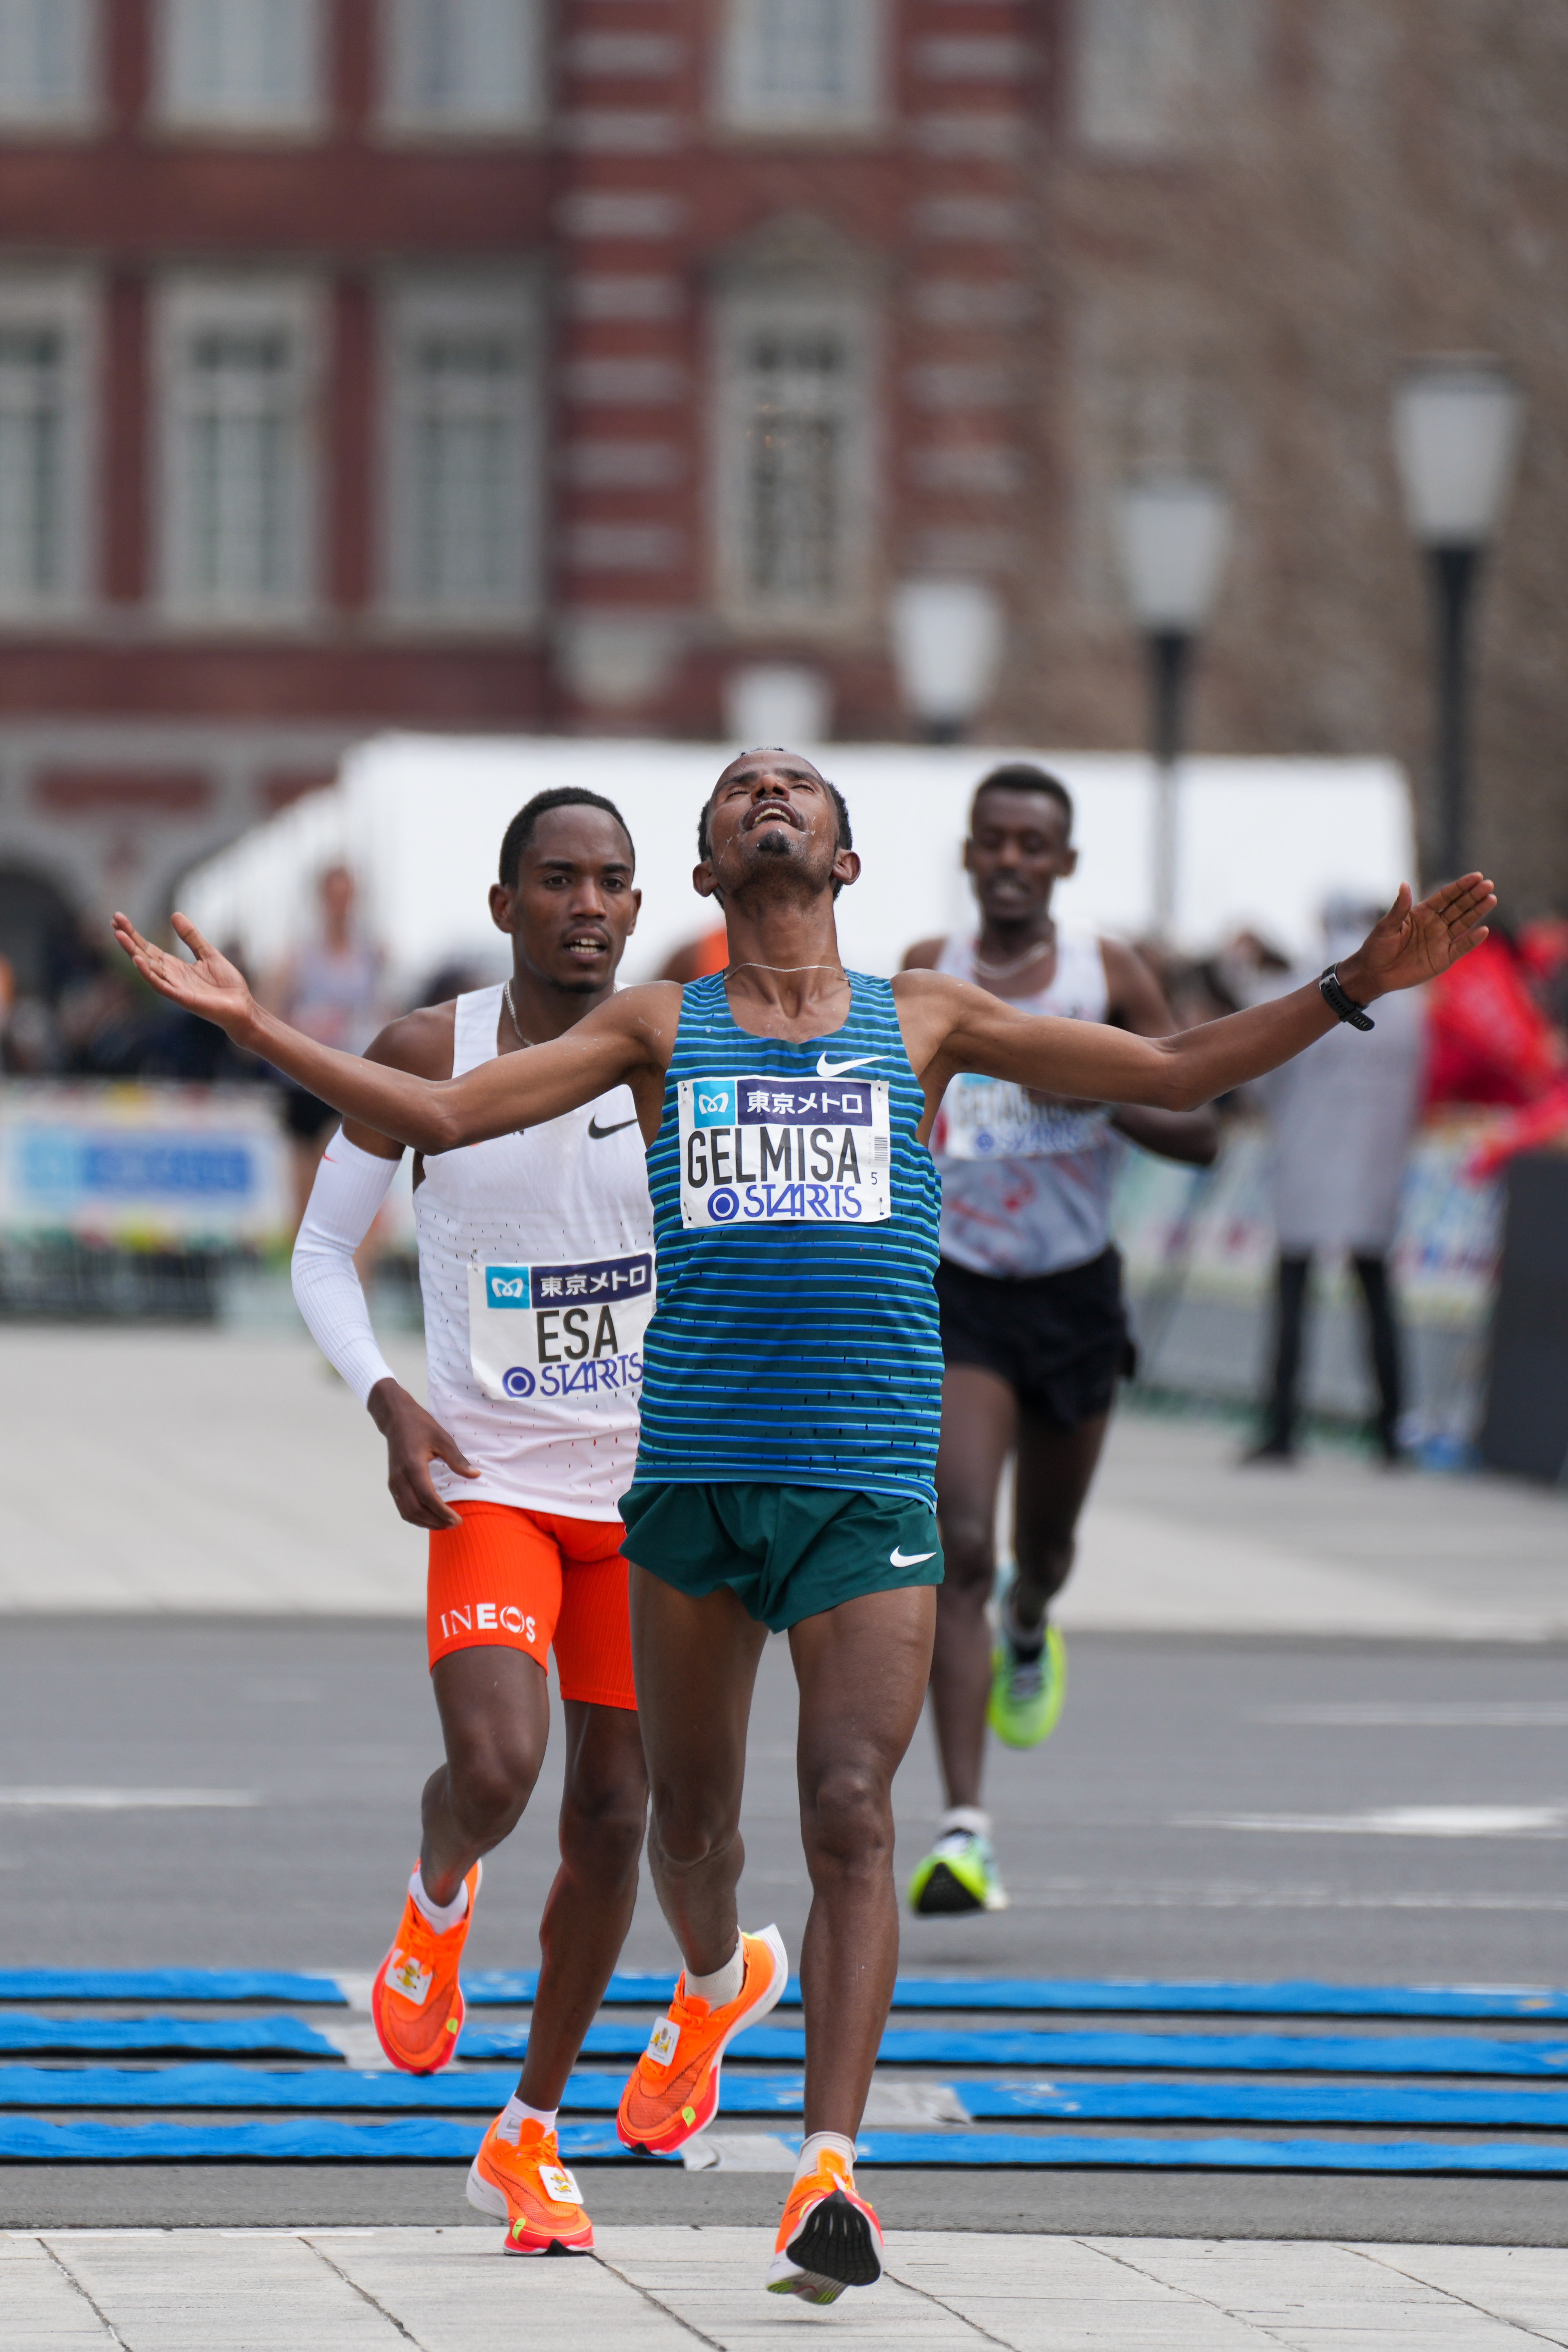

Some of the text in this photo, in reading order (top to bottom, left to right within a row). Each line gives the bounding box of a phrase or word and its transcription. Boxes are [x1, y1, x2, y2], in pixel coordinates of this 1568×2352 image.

[747, 1091, 862, 1114] 東京メトロ
[688, 1127, 861, 1188] GELMISA
[871, 1172, 878, 1185] 5
[540, 1265, 646, 1297] 東京メトロ
[536, 1305, 618, 1363] ESA
[440, 1603, 535, 1643] INEOS
